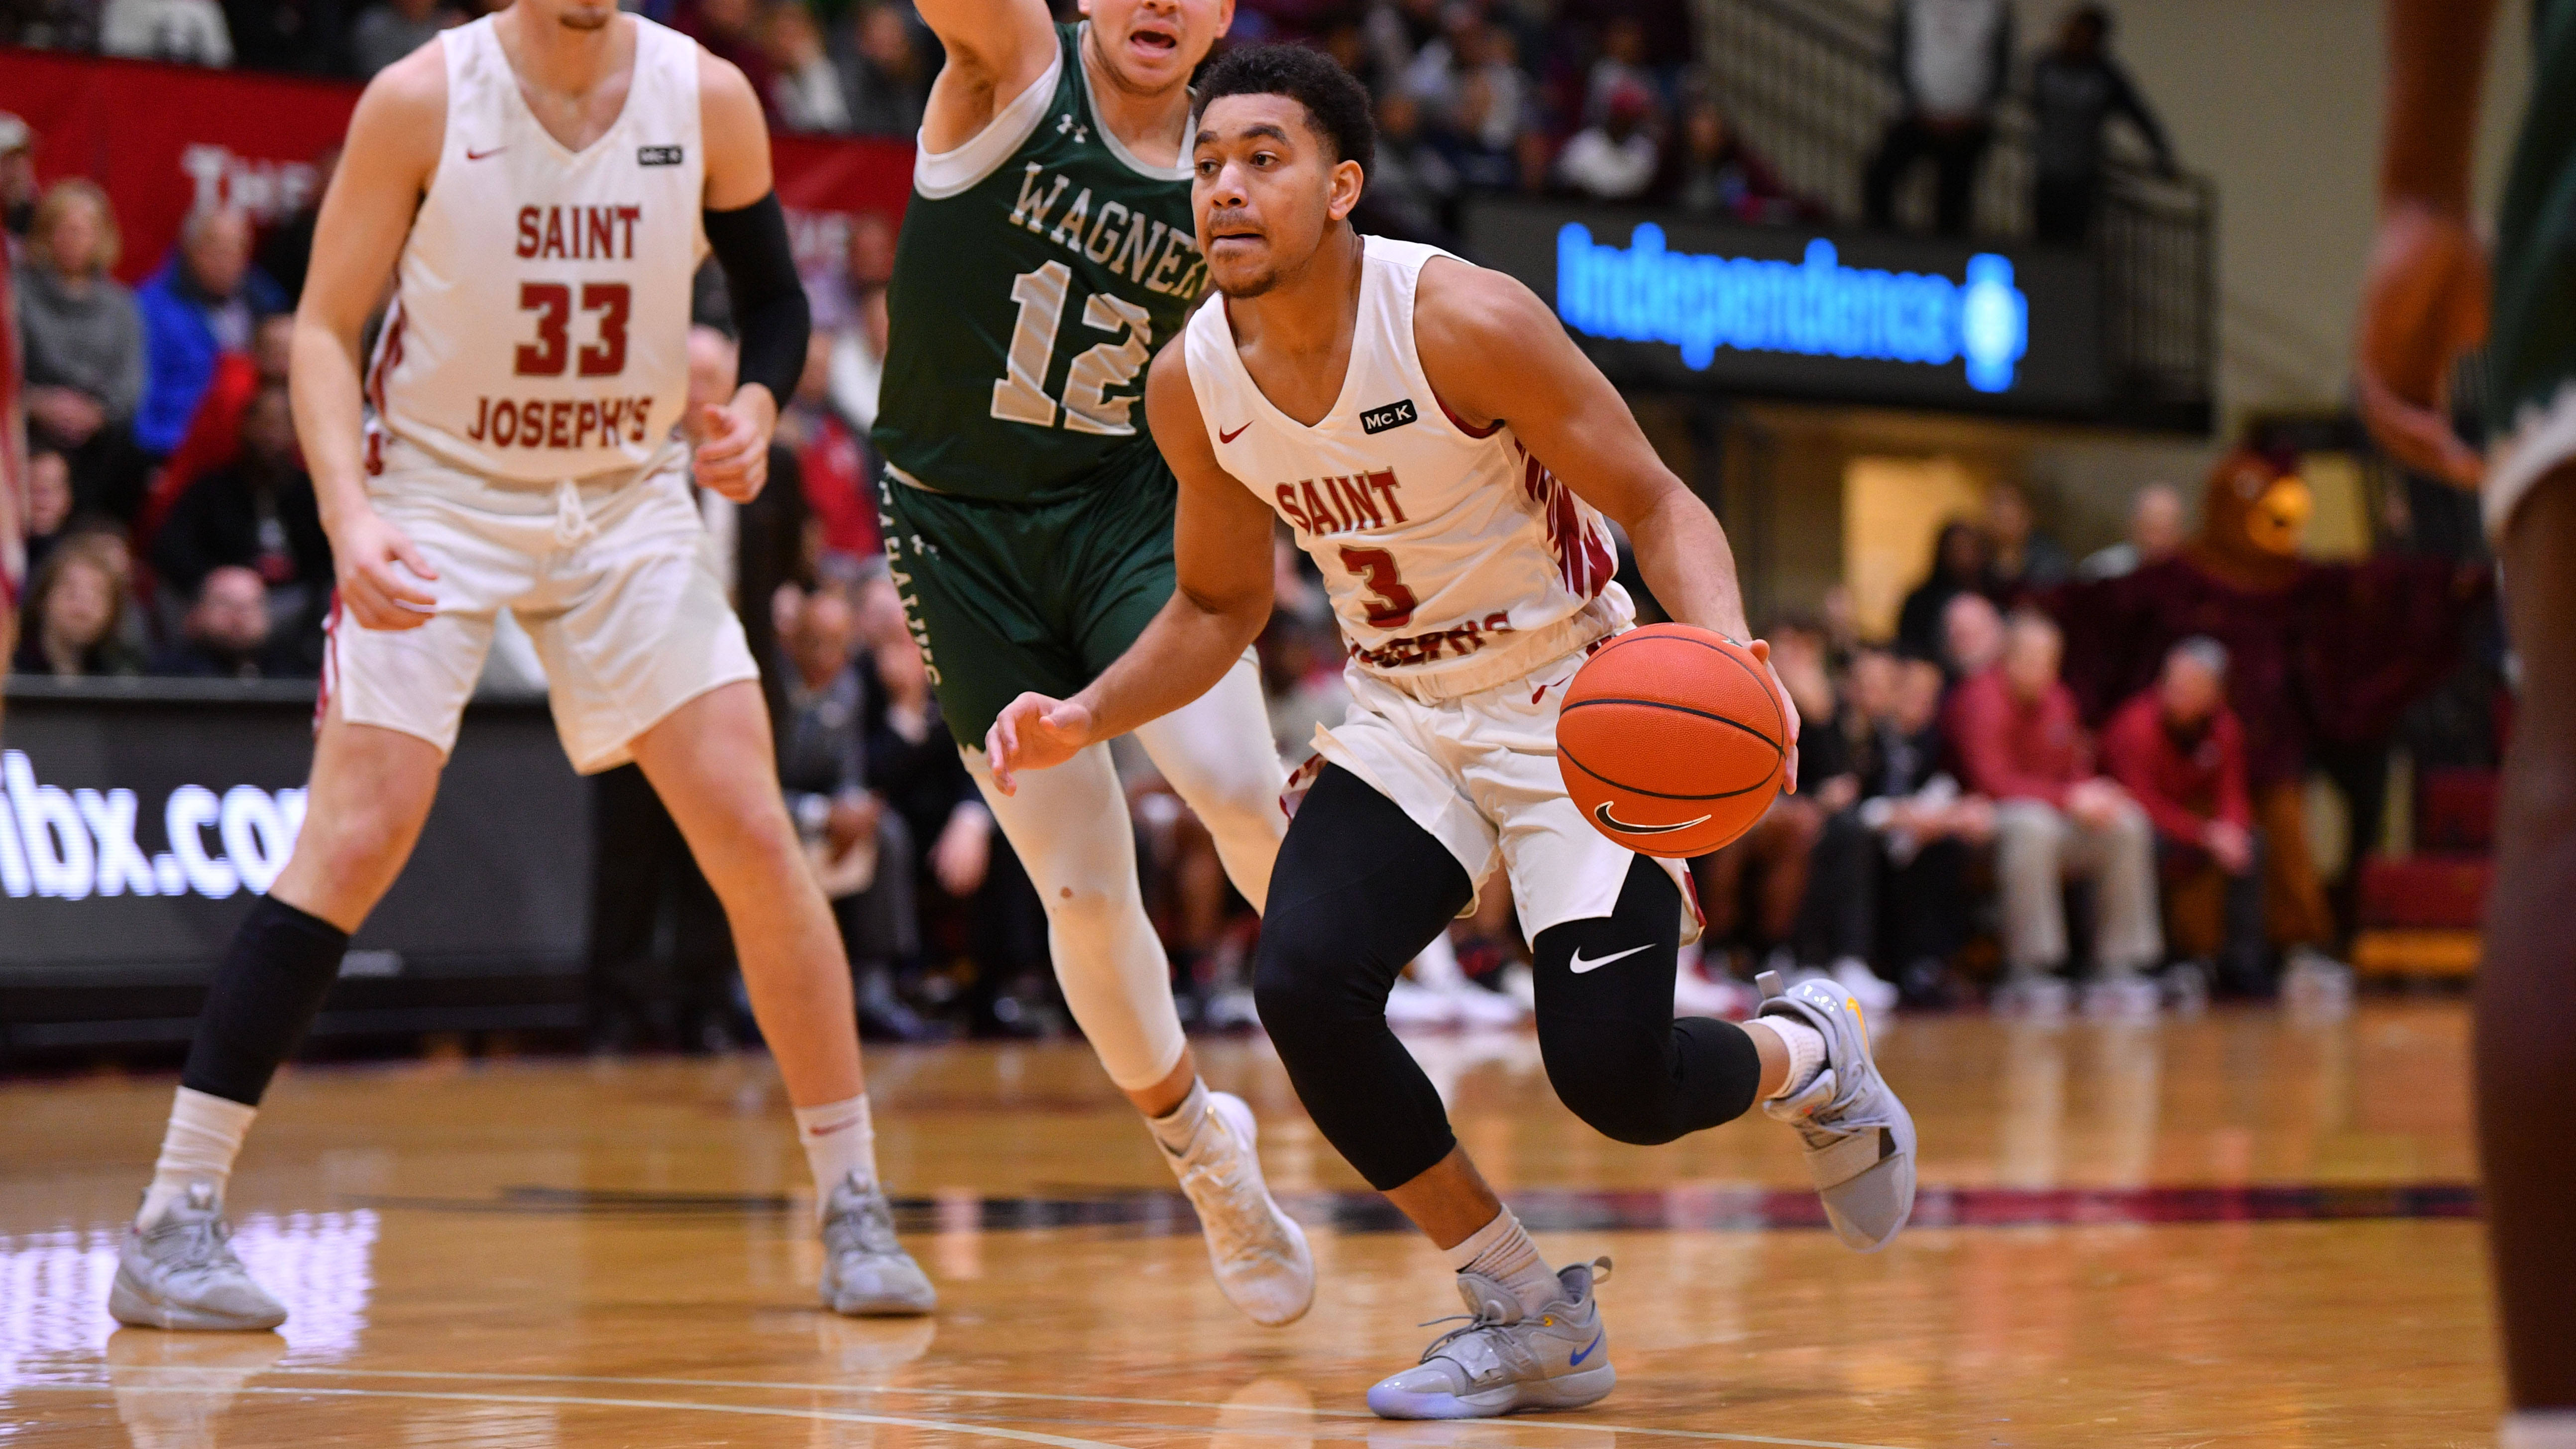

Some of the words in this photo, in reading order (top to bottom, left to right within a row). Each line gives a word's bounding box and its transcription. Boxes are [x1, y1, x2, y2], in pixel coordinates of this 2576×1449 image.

[516, 204, 641, 260] SAINT
[514, 280, 631, 378] 33
[1557, 222, 1964, 370] Independence
[991, 260, 1152, 435] 12
[467, 395, 652, 448] JOSEPH'S
[1275, 466, 1407, 537] SAINT
[1339, 544, 1419, 632] 3
